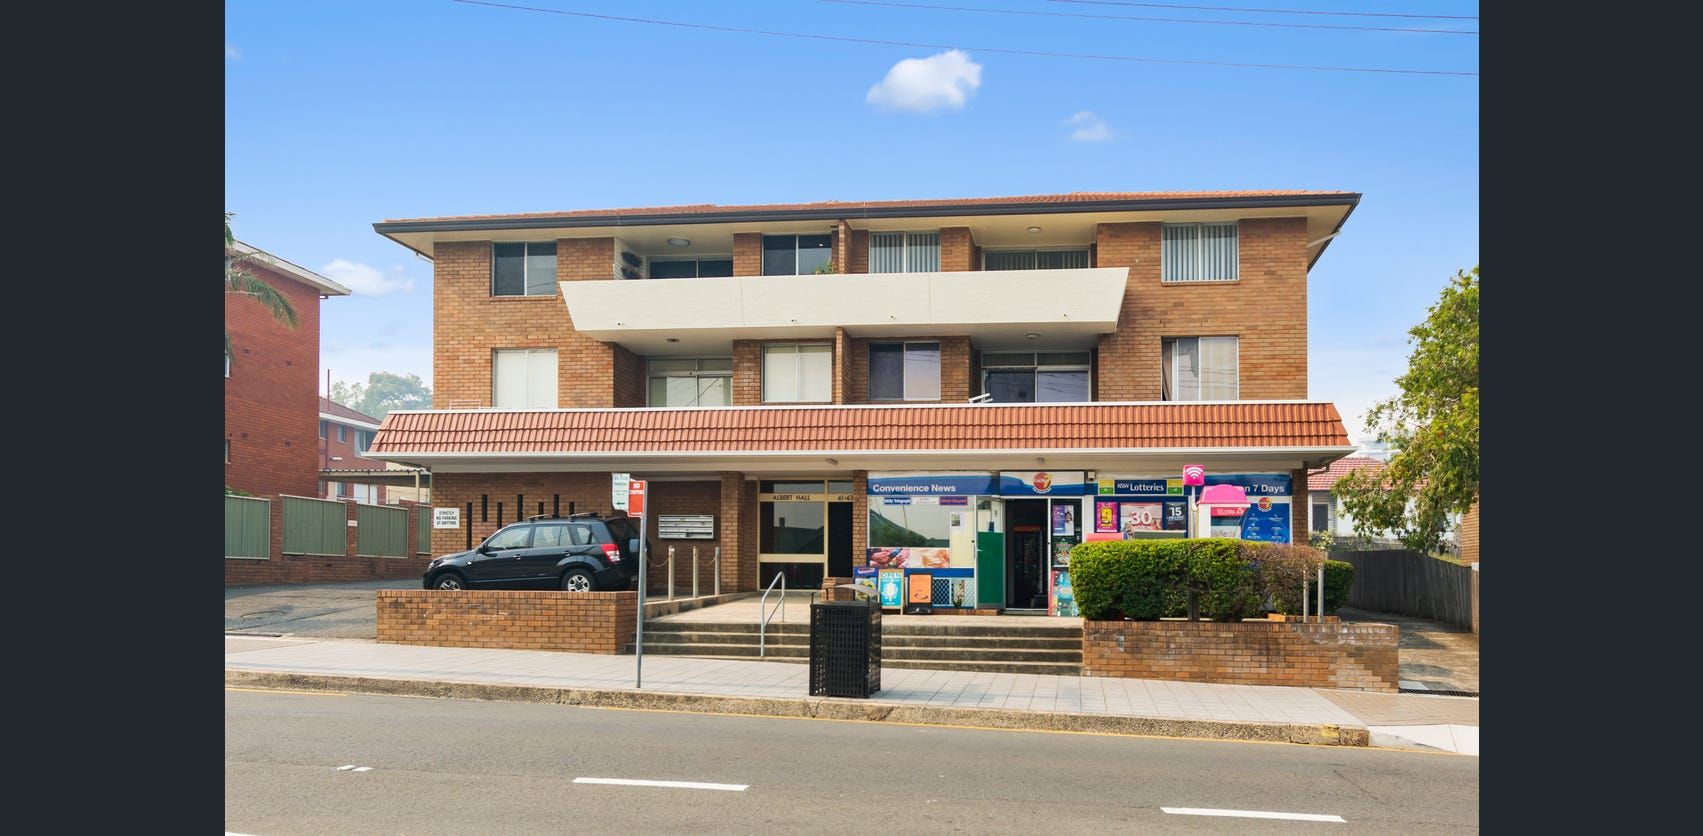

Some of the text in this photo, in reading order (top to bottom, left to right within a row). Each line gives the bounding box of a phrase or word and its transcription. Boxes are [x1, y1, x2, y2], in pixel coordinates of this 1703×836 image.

[872, 483, 957, 493] Convenience News
[1130, 483, 1165, 492] Lotteries
[1261, 484, 1285, 494] Days
[1131, 510, 1153, 525] 30
